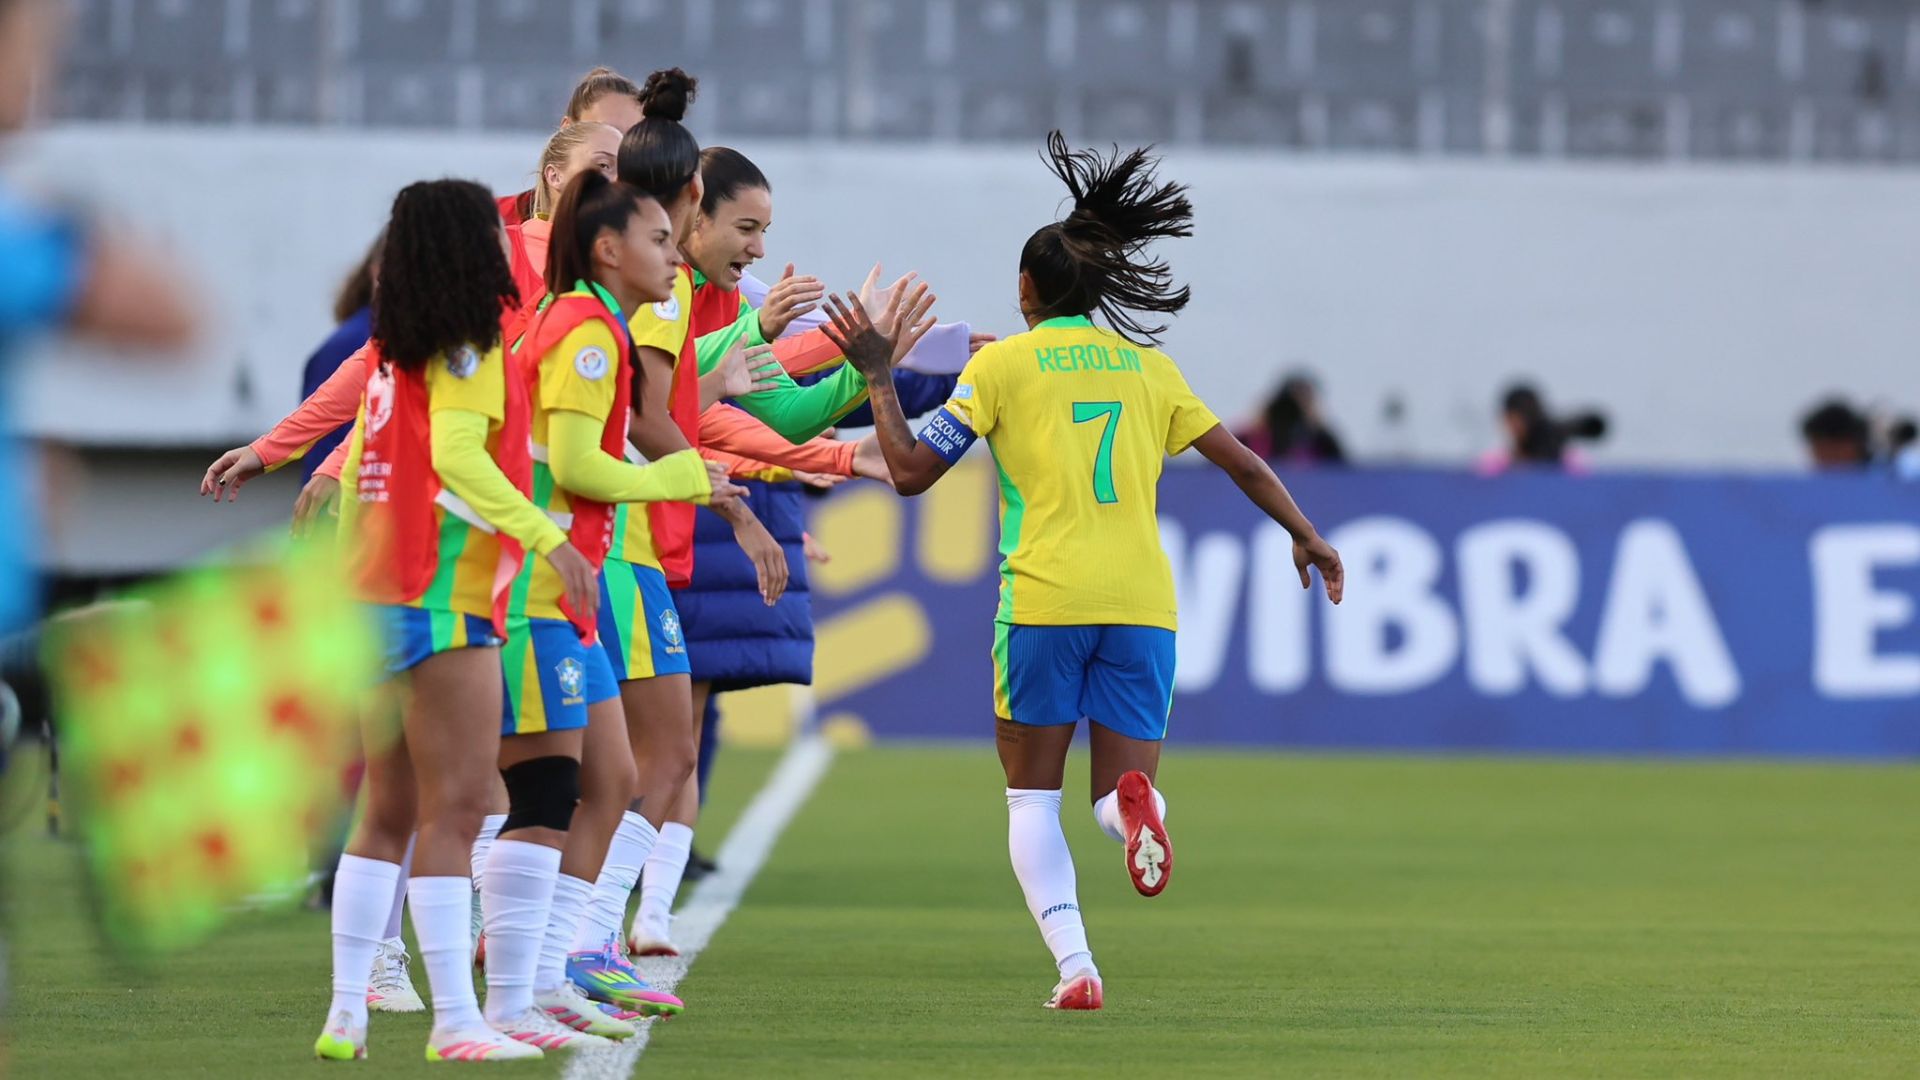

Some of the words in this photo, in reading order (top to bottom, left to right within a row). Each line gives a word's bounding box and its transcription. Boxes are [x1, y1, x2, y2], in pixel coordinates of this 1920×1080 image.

[1034, 343, 1143, 373] KEROLIN
[931, 414, 967, 449] ESCOLHA
[1072, 401, 1122, 504] 7
